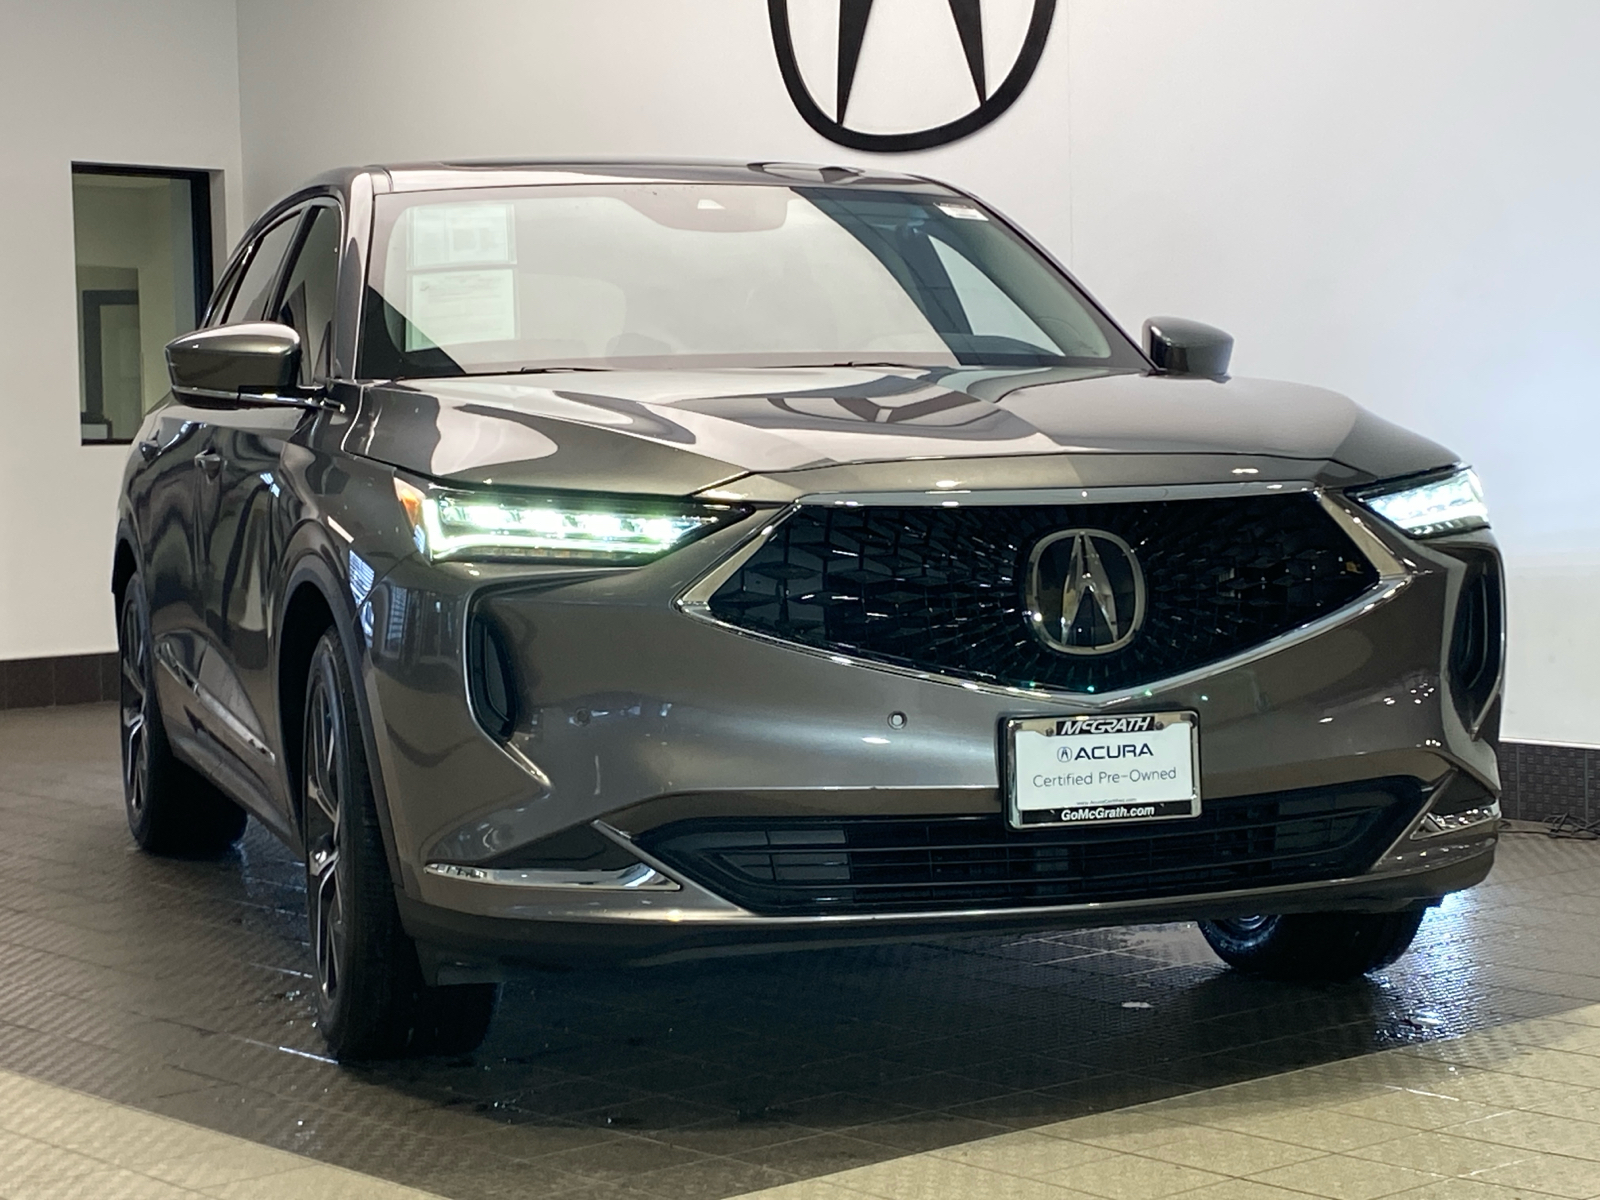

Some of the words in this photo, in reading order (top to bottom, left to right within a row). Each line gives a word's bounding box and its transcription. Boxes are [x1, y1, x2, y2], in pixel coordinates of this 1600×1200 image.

[1074, 743, 1154, 761] ACURA
[1033, 772, 1093, 788] Certified
[1098, 767, 1177, 784] Pre-Owned
[1061, 806, 1155, 821] GoMcGrath.com
